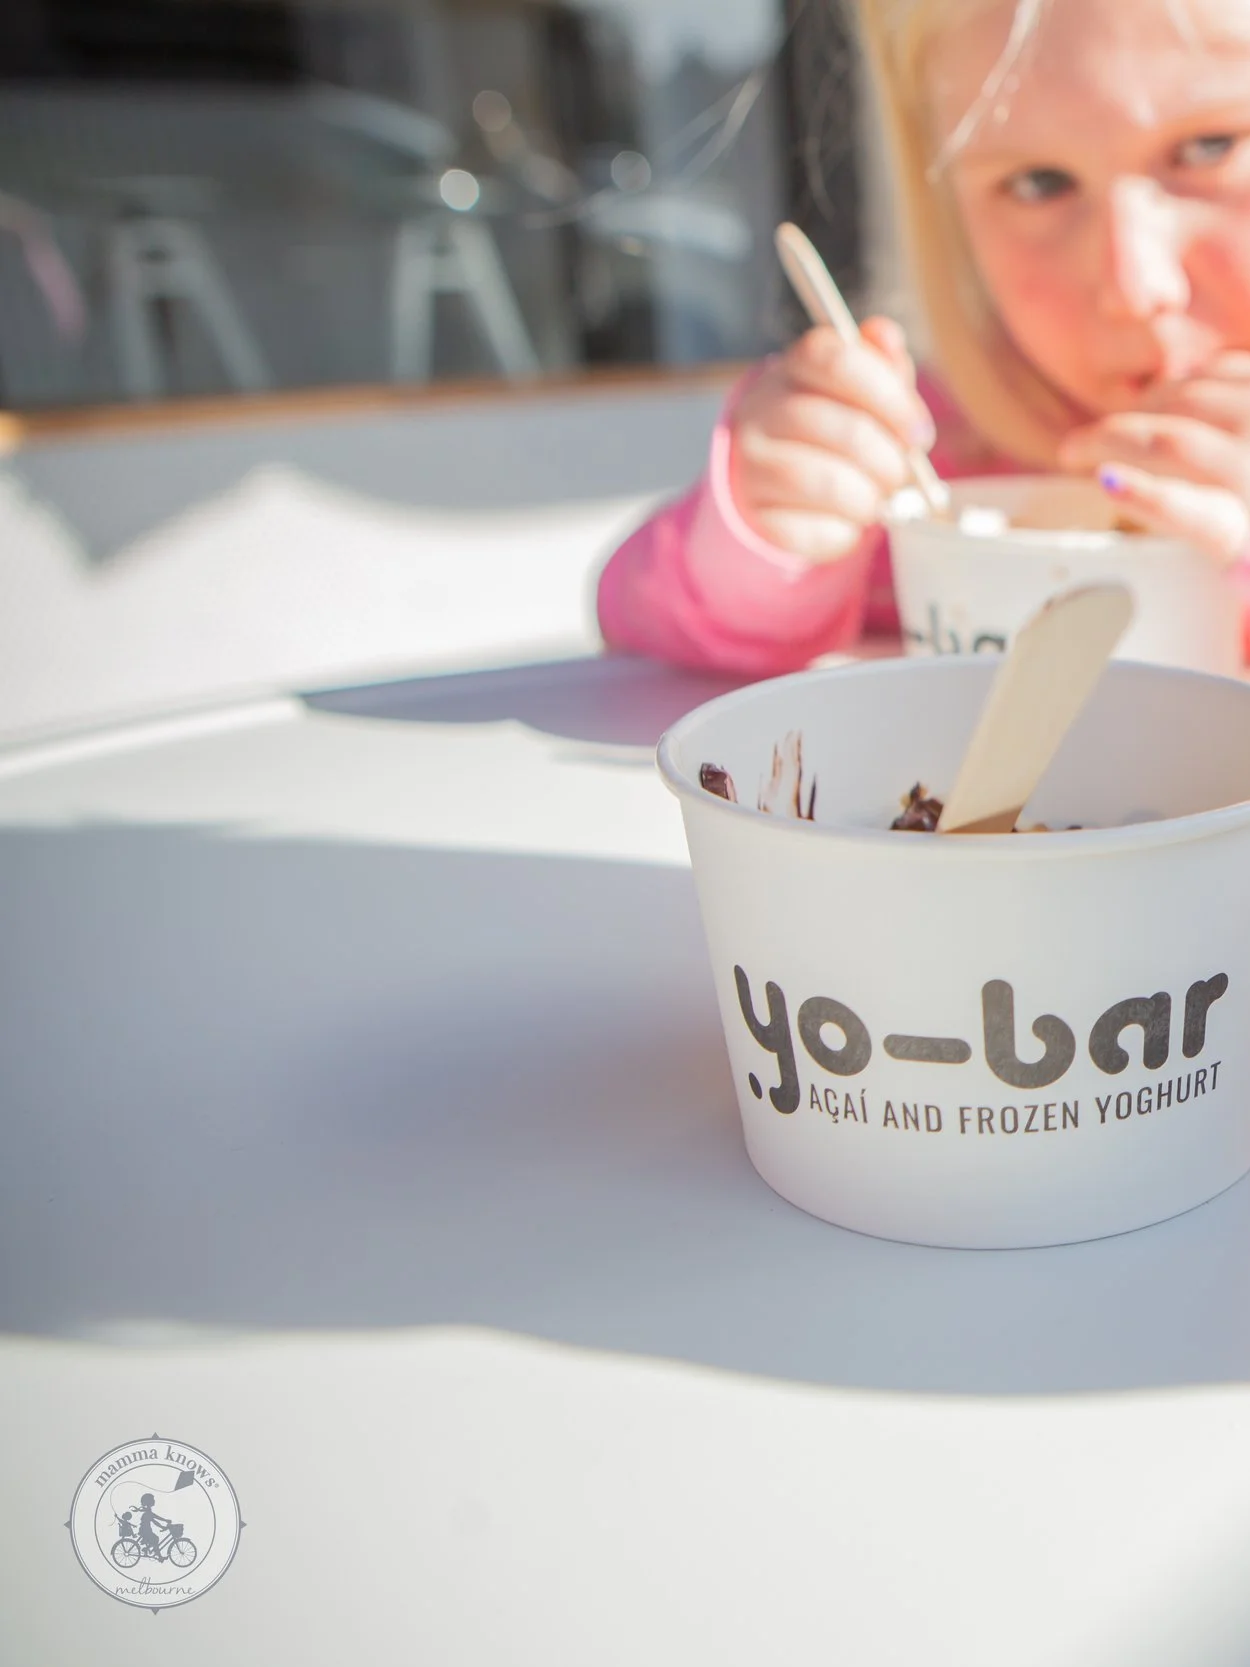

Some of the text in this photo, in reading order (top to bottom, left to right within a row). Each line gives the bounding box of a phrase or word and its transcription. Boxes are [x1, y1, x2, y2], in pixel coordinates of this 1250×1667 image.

[733, 964, 1229, 1115] yo-bar
[809, 1060, 1222, 1135] AÇAÍ AND FROZEN YOGHURT
